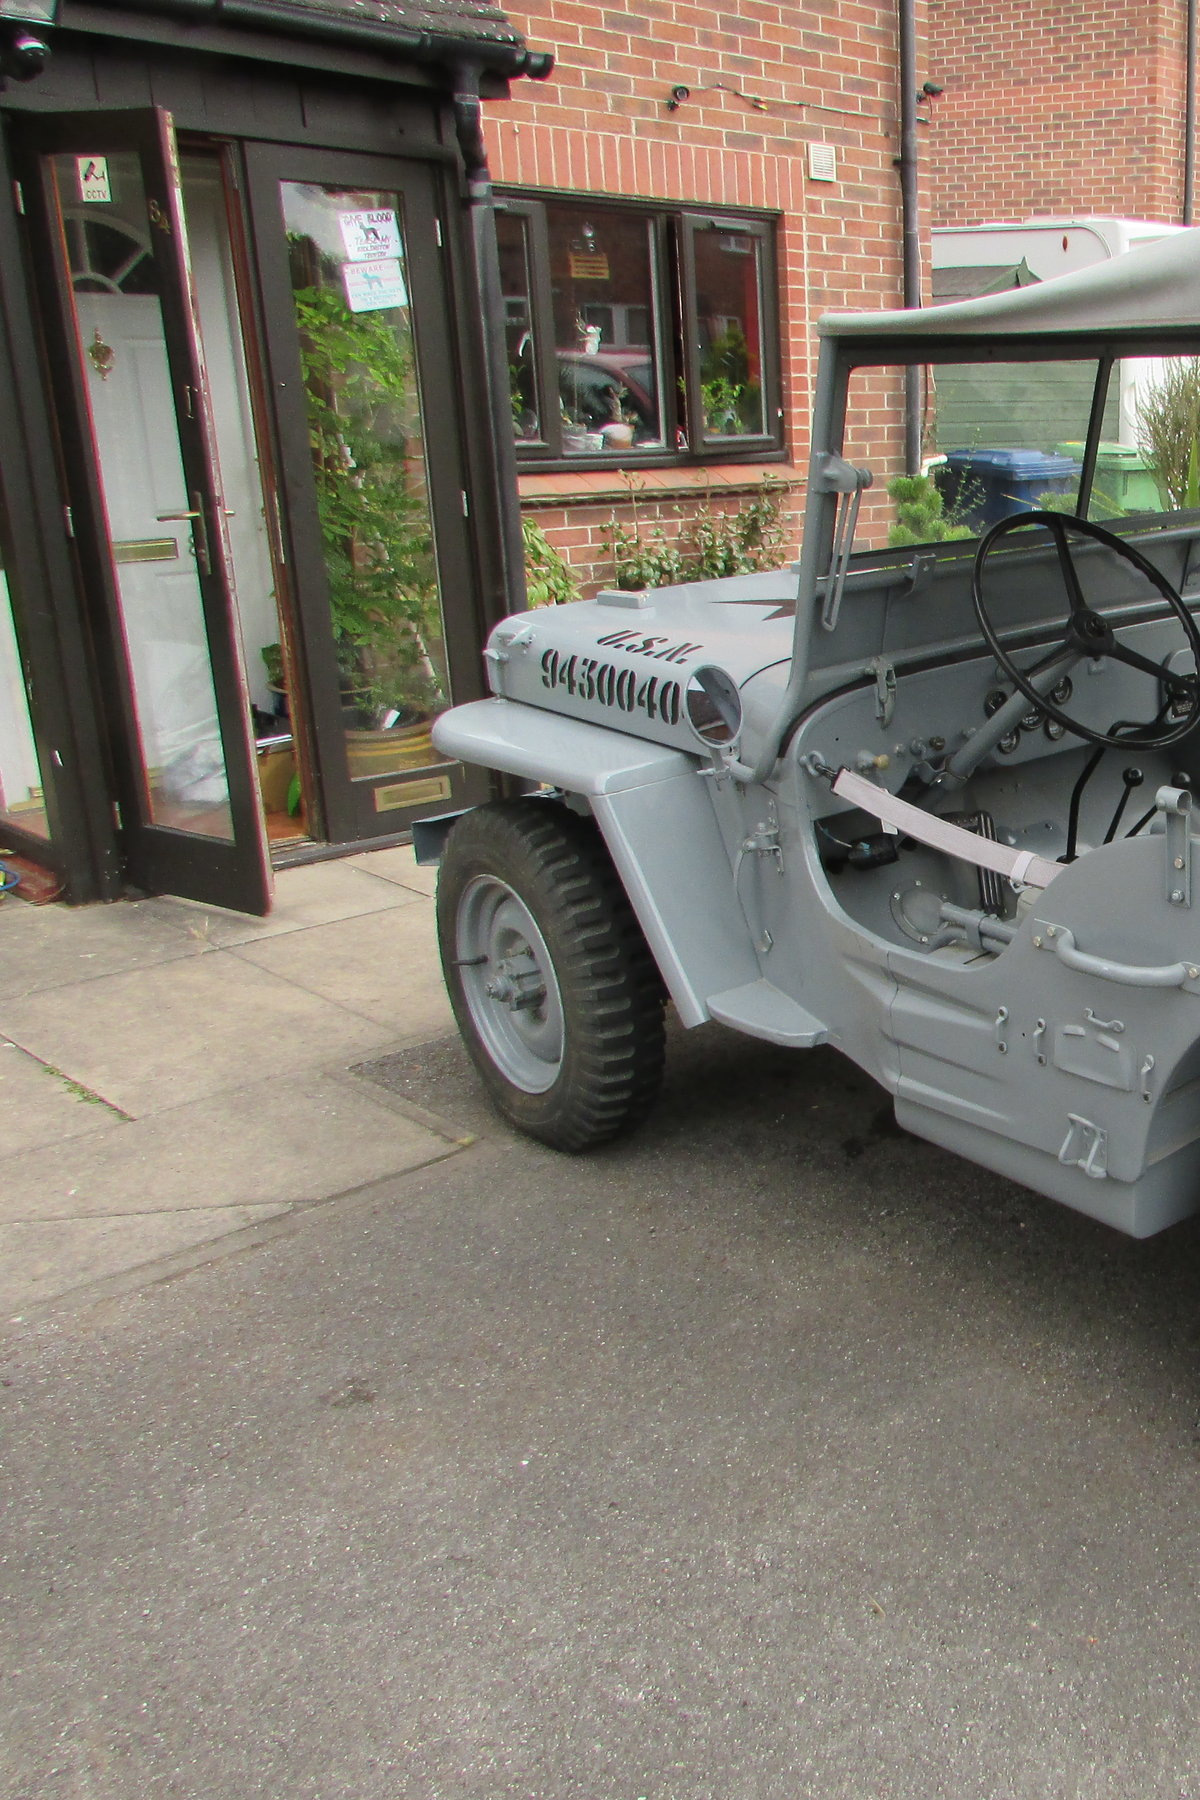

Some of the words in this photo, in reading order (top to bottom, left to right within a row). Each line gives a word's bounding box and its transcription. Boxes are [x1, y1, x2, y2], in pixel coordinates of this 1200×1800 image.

[86, 190, 107, 199] CCTV
[367, 212, 392, 223] BLOOD
[351, 264, 385, 275] BEWARE
[541, 648, 682, 726] 9430040
